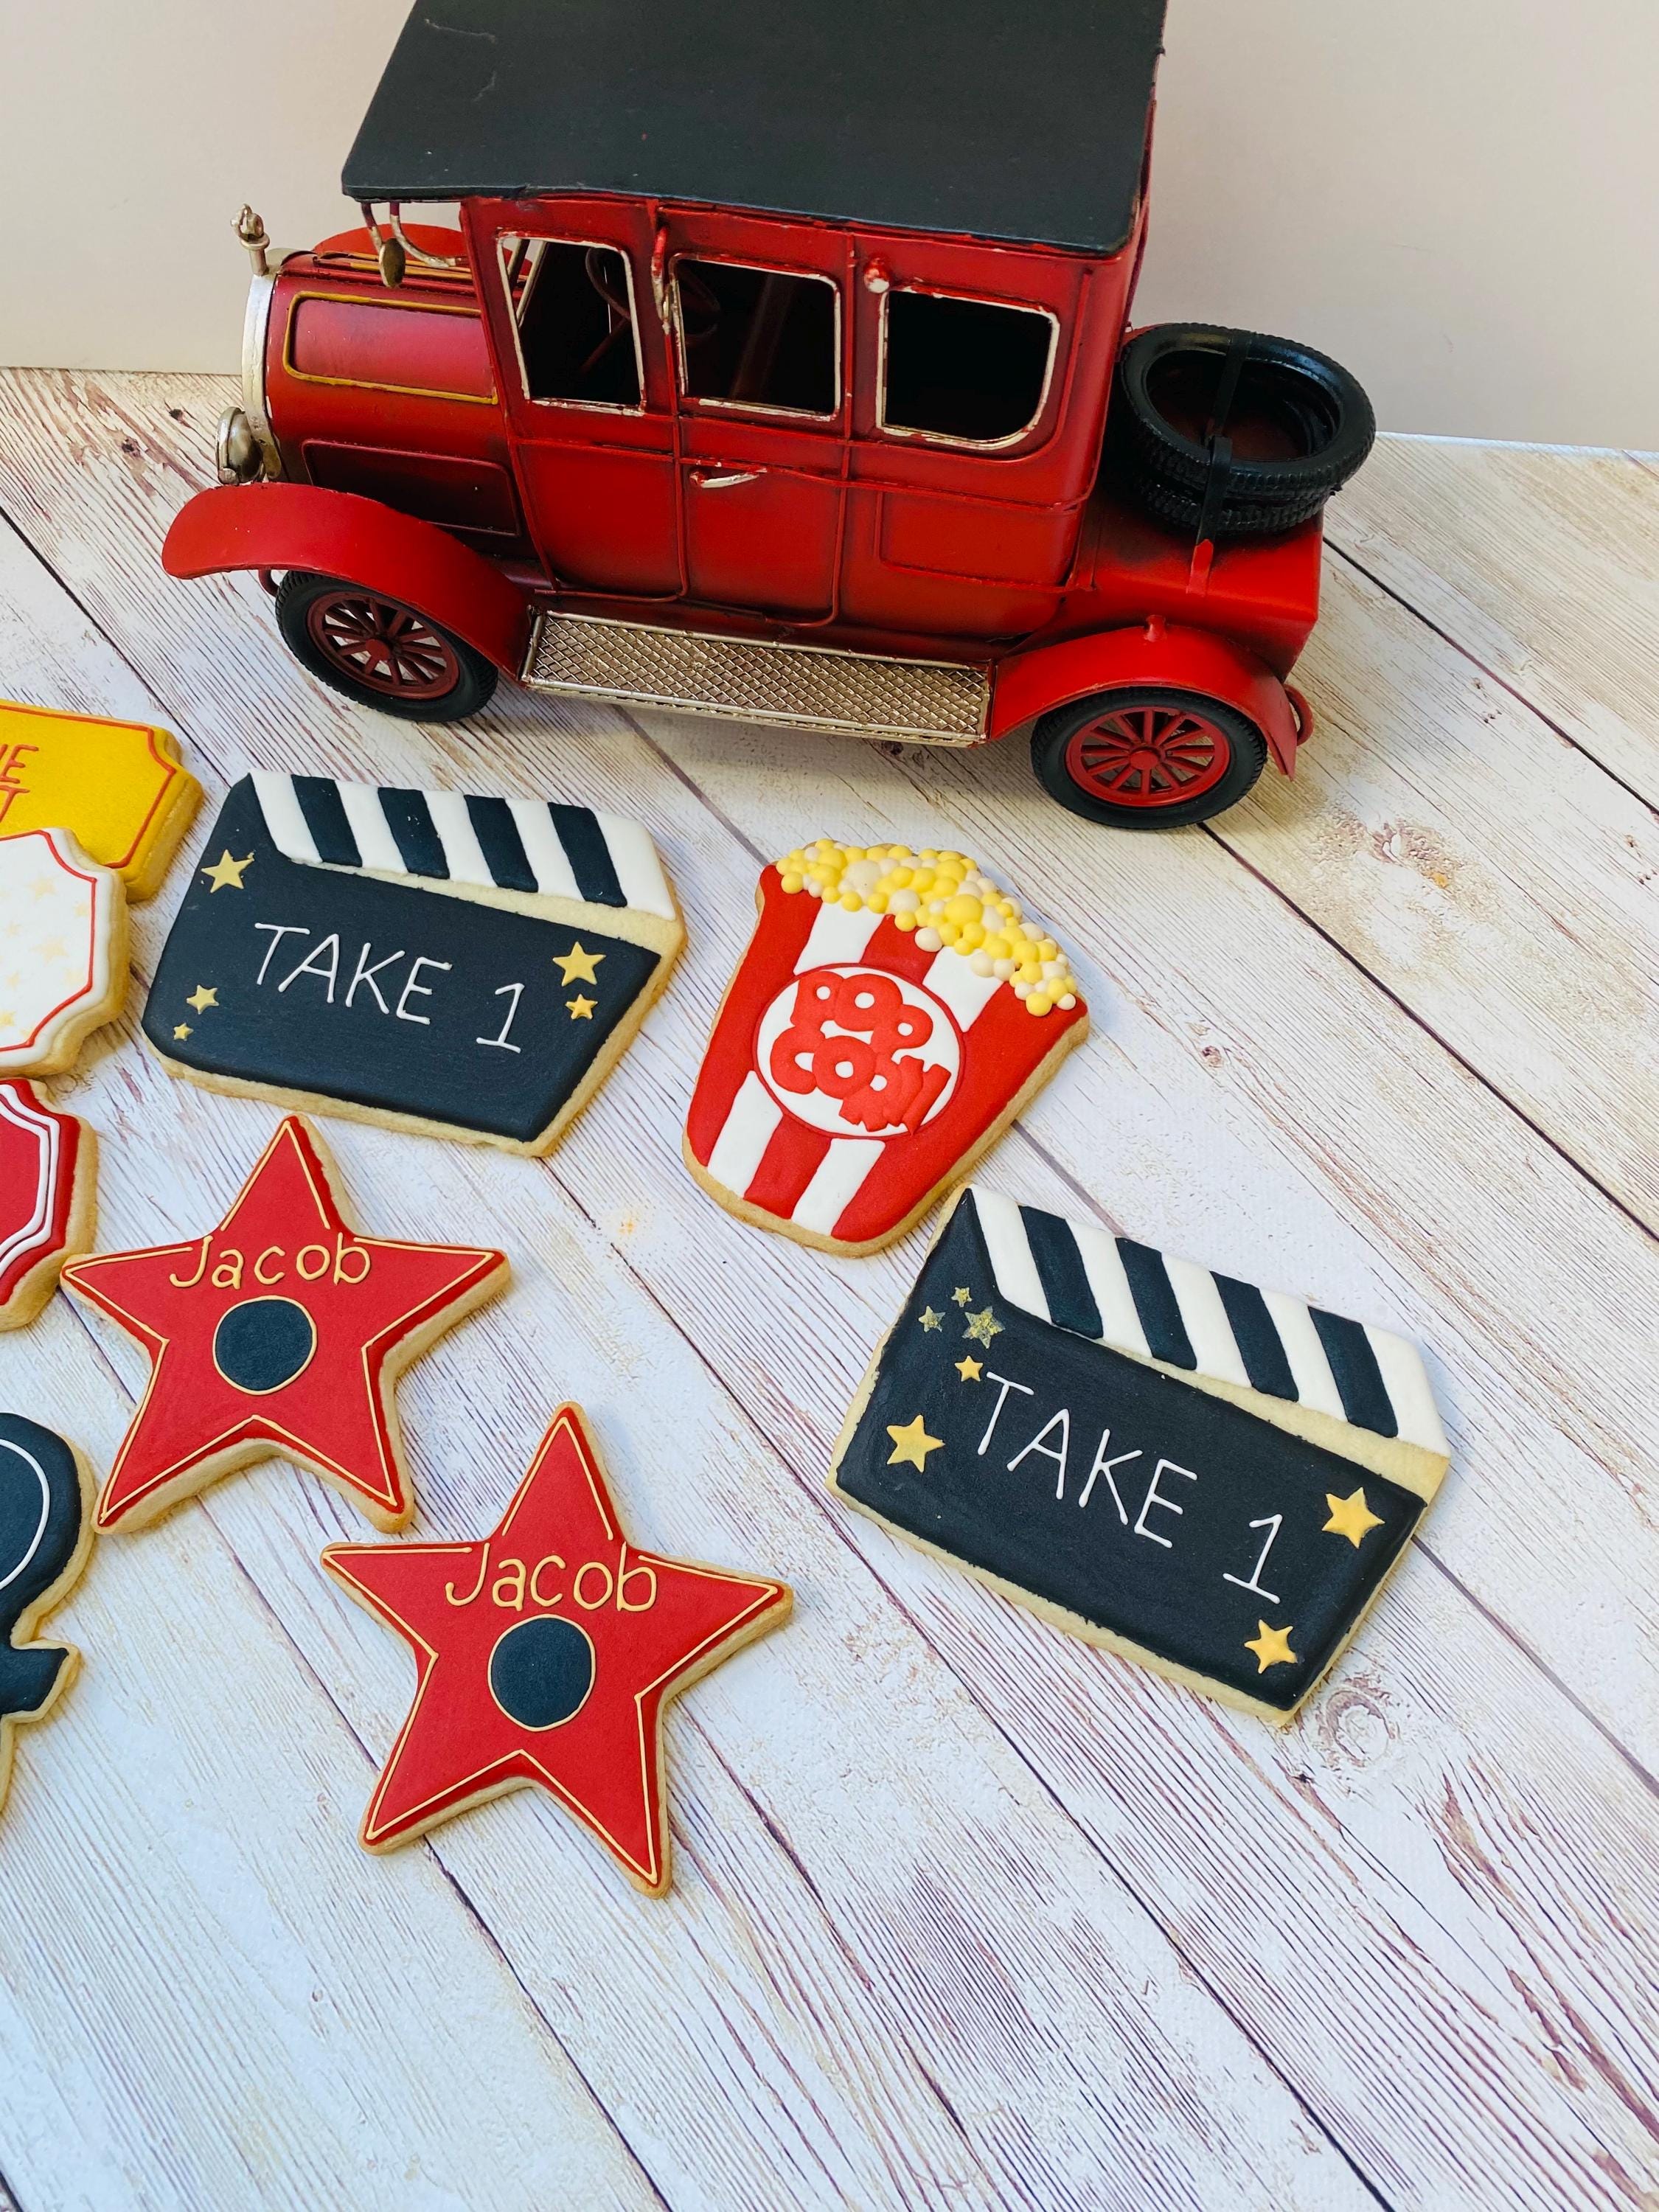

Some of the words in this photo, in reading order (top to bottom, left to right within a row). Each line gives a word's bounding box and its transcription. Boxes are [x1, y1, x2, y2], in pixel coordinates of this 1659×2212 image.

[254, 922, 452, 1025] TAKE
[476, 983, 526, 1054] 1
[790, 970, 933, 1059] POP
[770, 1026, 952, 1135] CORN
[169, 1232, 371, 1290] Jacob
[977, 1371, 1197, 1548] TAKE
[1222, 1514, 1283, 1604] 1
[445, 1541, 657, 1613] Jacob
